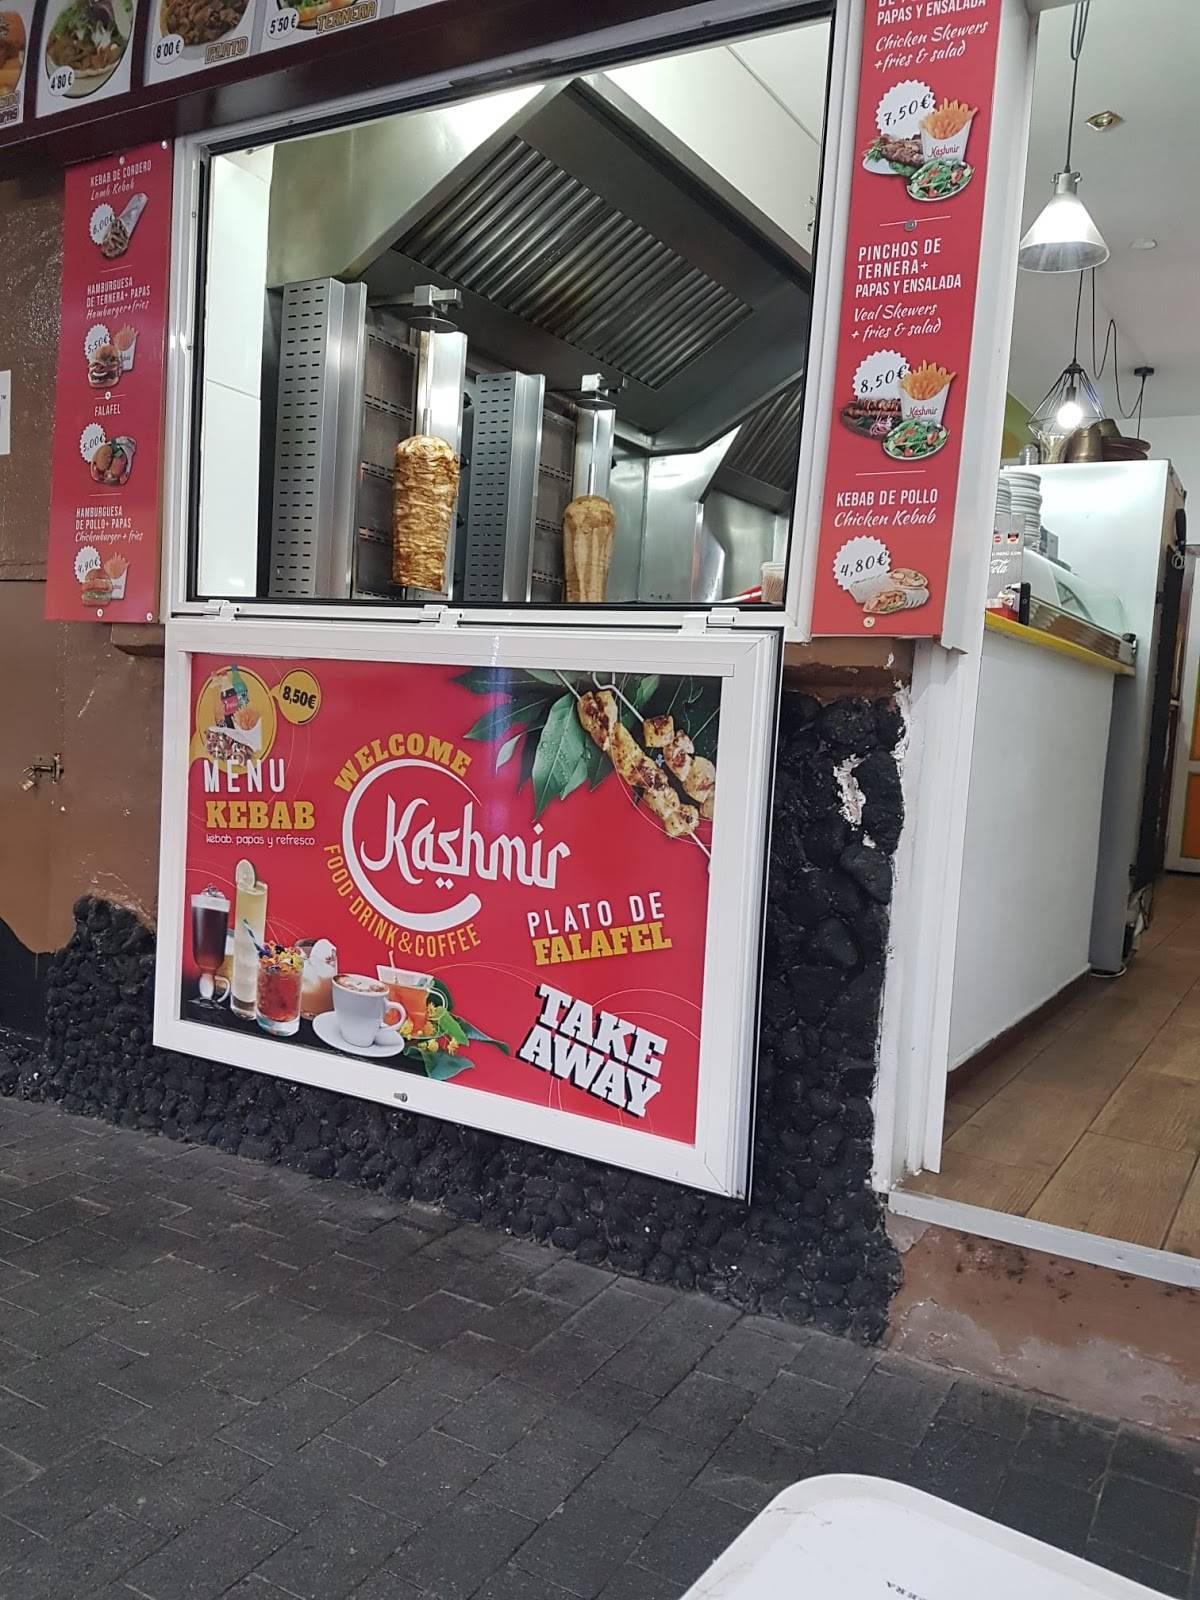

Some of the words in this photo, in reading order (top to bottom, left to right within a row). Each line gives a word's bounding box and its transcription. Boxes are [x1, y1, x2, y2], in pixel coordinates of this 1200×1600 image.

[315, 1, 378, 34] TERNERA
[877, 6, 912, 26] PAPAS
[916, 4, 924, 18] Y
[875, 30, 927, 52] Chicken
[931, 21, 989, 42] Skewers
[915, 48, 929, 64] &
[930, 40, 967, 63] salad
[883, 93, 931, 127] 7,50€
[90, 171, 111, 187] KEBAB
[112, 168, 121, 181] DE
[122, 159, 152, 178] CORDERO
[90, 184, 110, 201] Lamb
[112, 177, 135, 195] Kebab
[858, 240, 918, 262] PINCHOS
[923, 237, 942, 255] DE
[86, 296, 95, 308] DE
[130, 285, 150, 299] PAPAS
[87, 276, 133, 296] HAMBURGUESA
[855, 281, 890, 299] PAPAS
[893, 280, 901, 294] Y
[902, 273, 962, 294] ENSALADA
[854, 304, 883, 322] Veal
[882, 302, 938, 319] Skewers
[862, 324, 892, 342] fries
[894, 322, 906, 337] &
[907, 317, 942, 336] salad
[94, 403, 121, 417] FALAFEL
[836, 491, 875, 507] KEBAB
[879, 489, 897, 505] DE
[900, 488, 938, 504] POLLO
[75, 518, 84, 530] DE
[111, 518, 132, 529] PAPAS
[76, 505, 123, 518] HAMBURGUESA
[834, 510, 888, 528] Chicken
[892, 507, 936, 526] Kebab
[840, 551, 887, 577] 4,80€
[282, 686, 317, 710] 8,50€
[203, 758, 286, 793] MENU
[334, 732, 473, 794] WELCOME
[206, 800, 315, 830] KEBAB
[236, 835, 265, 846] papas
[267, 836, 274, 848] y
[276, 834, 316, 846] refresco
[360, 794, 571, 889] Kashmir
[527, 899, 613, 938] PLATO
[629, 891, 665, 923] DE
[532, 921, 673, 966] FALAFEL
[534, 982, 668, 1078] TAKE
[516, 1023, 662, 1119] AWAY
